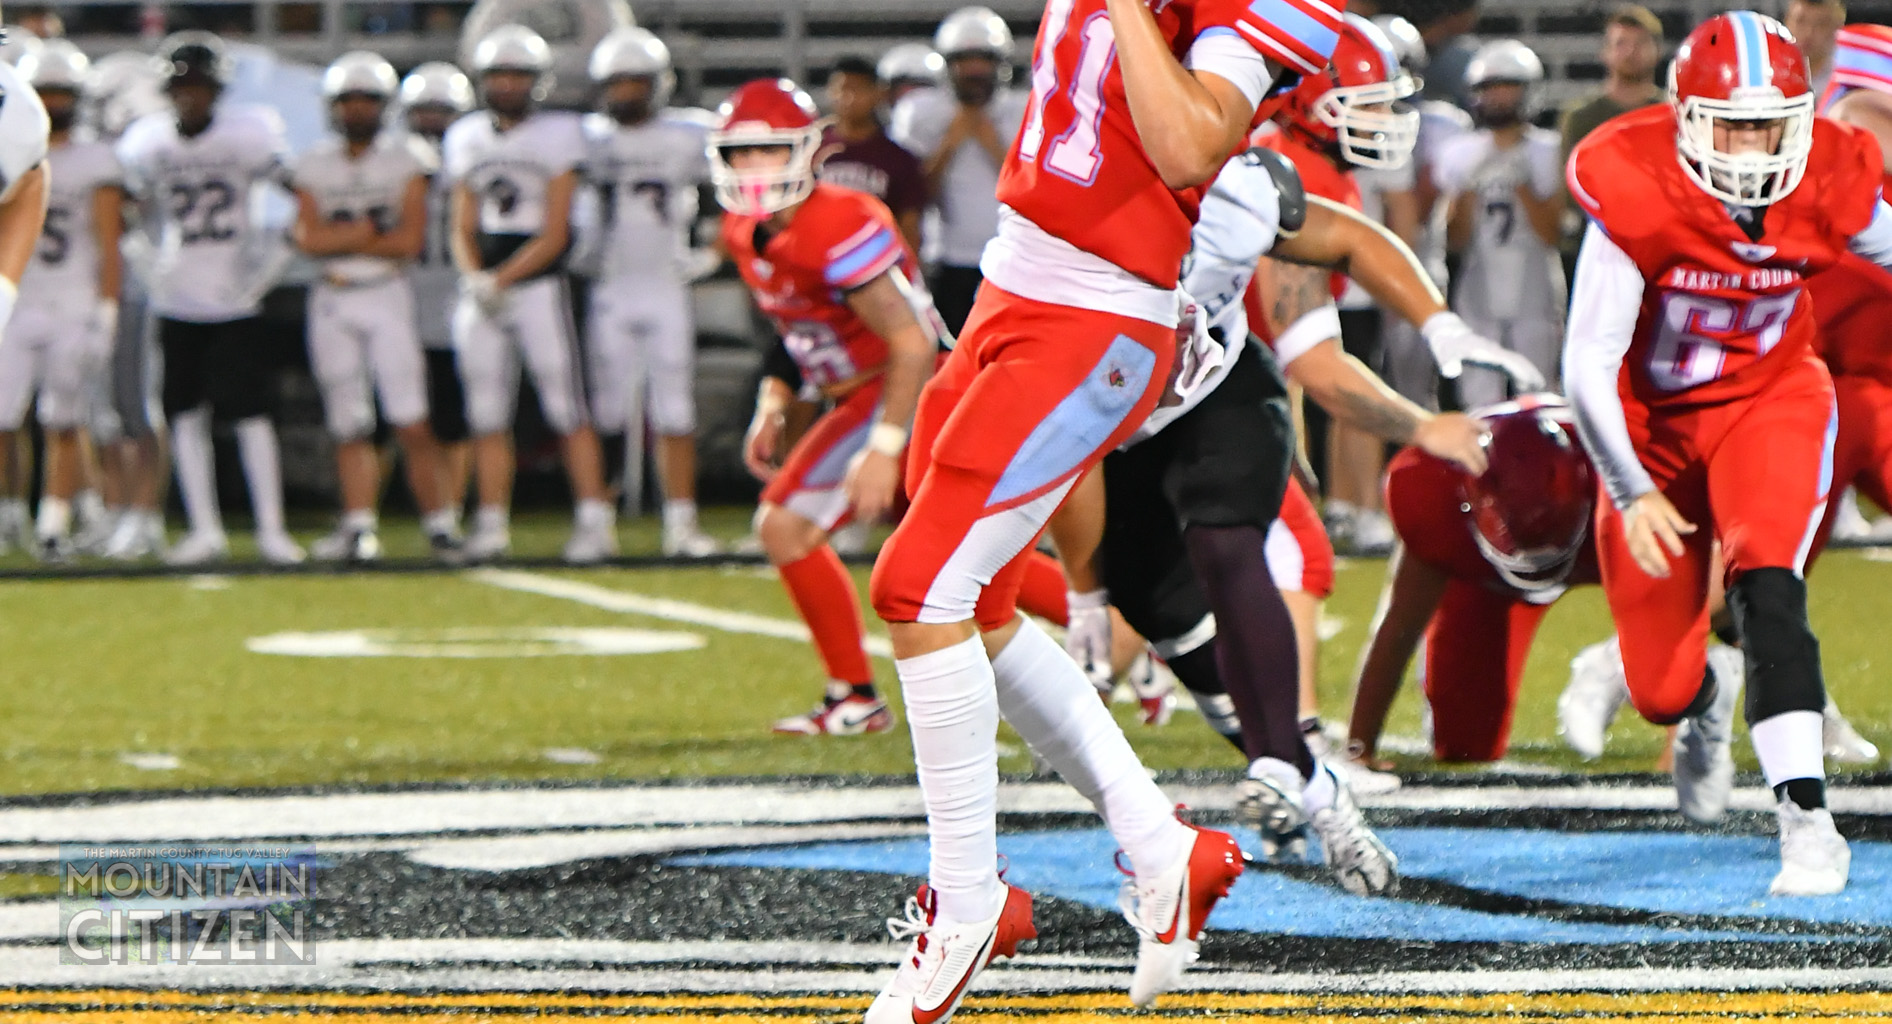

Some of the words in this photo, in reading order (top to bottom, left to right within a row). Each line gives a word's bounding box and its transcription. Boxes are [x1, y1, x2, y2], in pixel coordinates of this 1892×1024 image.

[170, 178, 237, 244] 22
[1486, 201, 1515, 247] 7
[1671, 266, 1743, 290] MARTIN
[1749, 268, 1800, 290] COUN
[1649, 288, 1801, 391] 67
